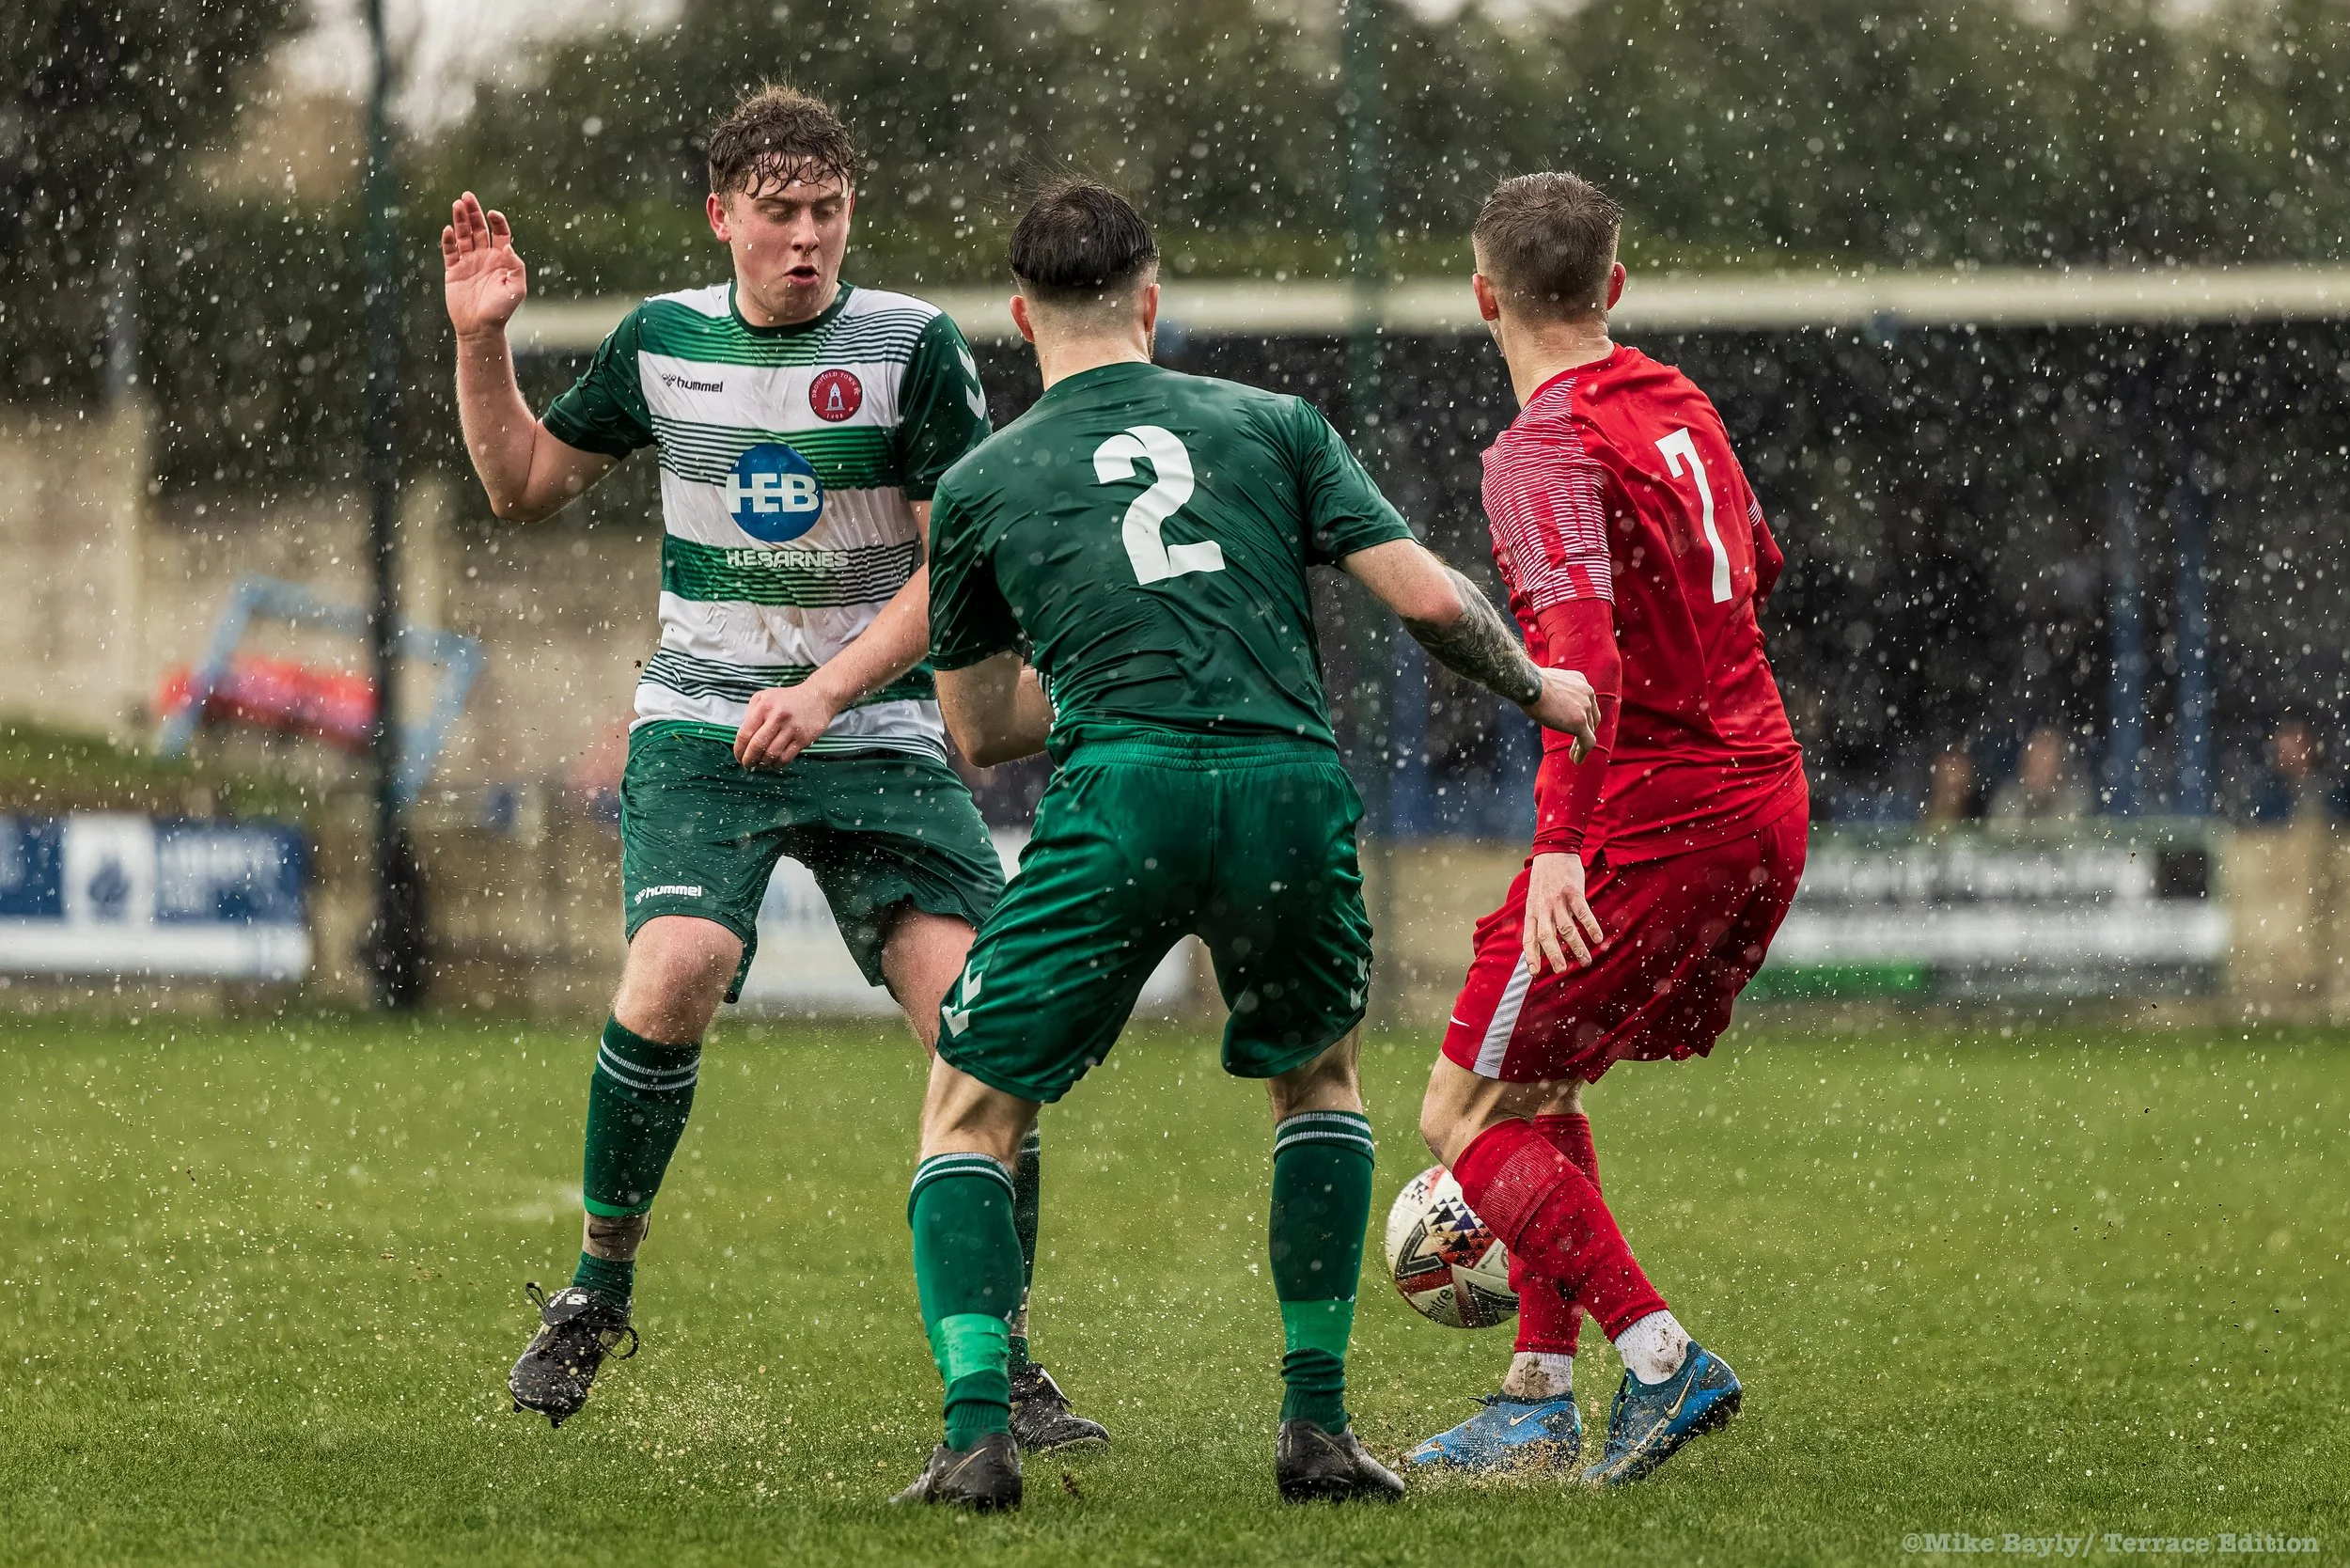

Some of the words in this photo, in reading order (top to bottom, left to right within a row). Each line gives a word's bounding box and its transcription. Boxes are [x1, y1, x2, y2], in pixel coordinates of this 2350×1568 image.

[677, 376, 724, 393] hummel
[726, 473, 820, 513] HEB
[1092, 425, 1226, 587] 2
[1654, 427, 1733, 604] 7
[645, 885, 702, 900] hummel
